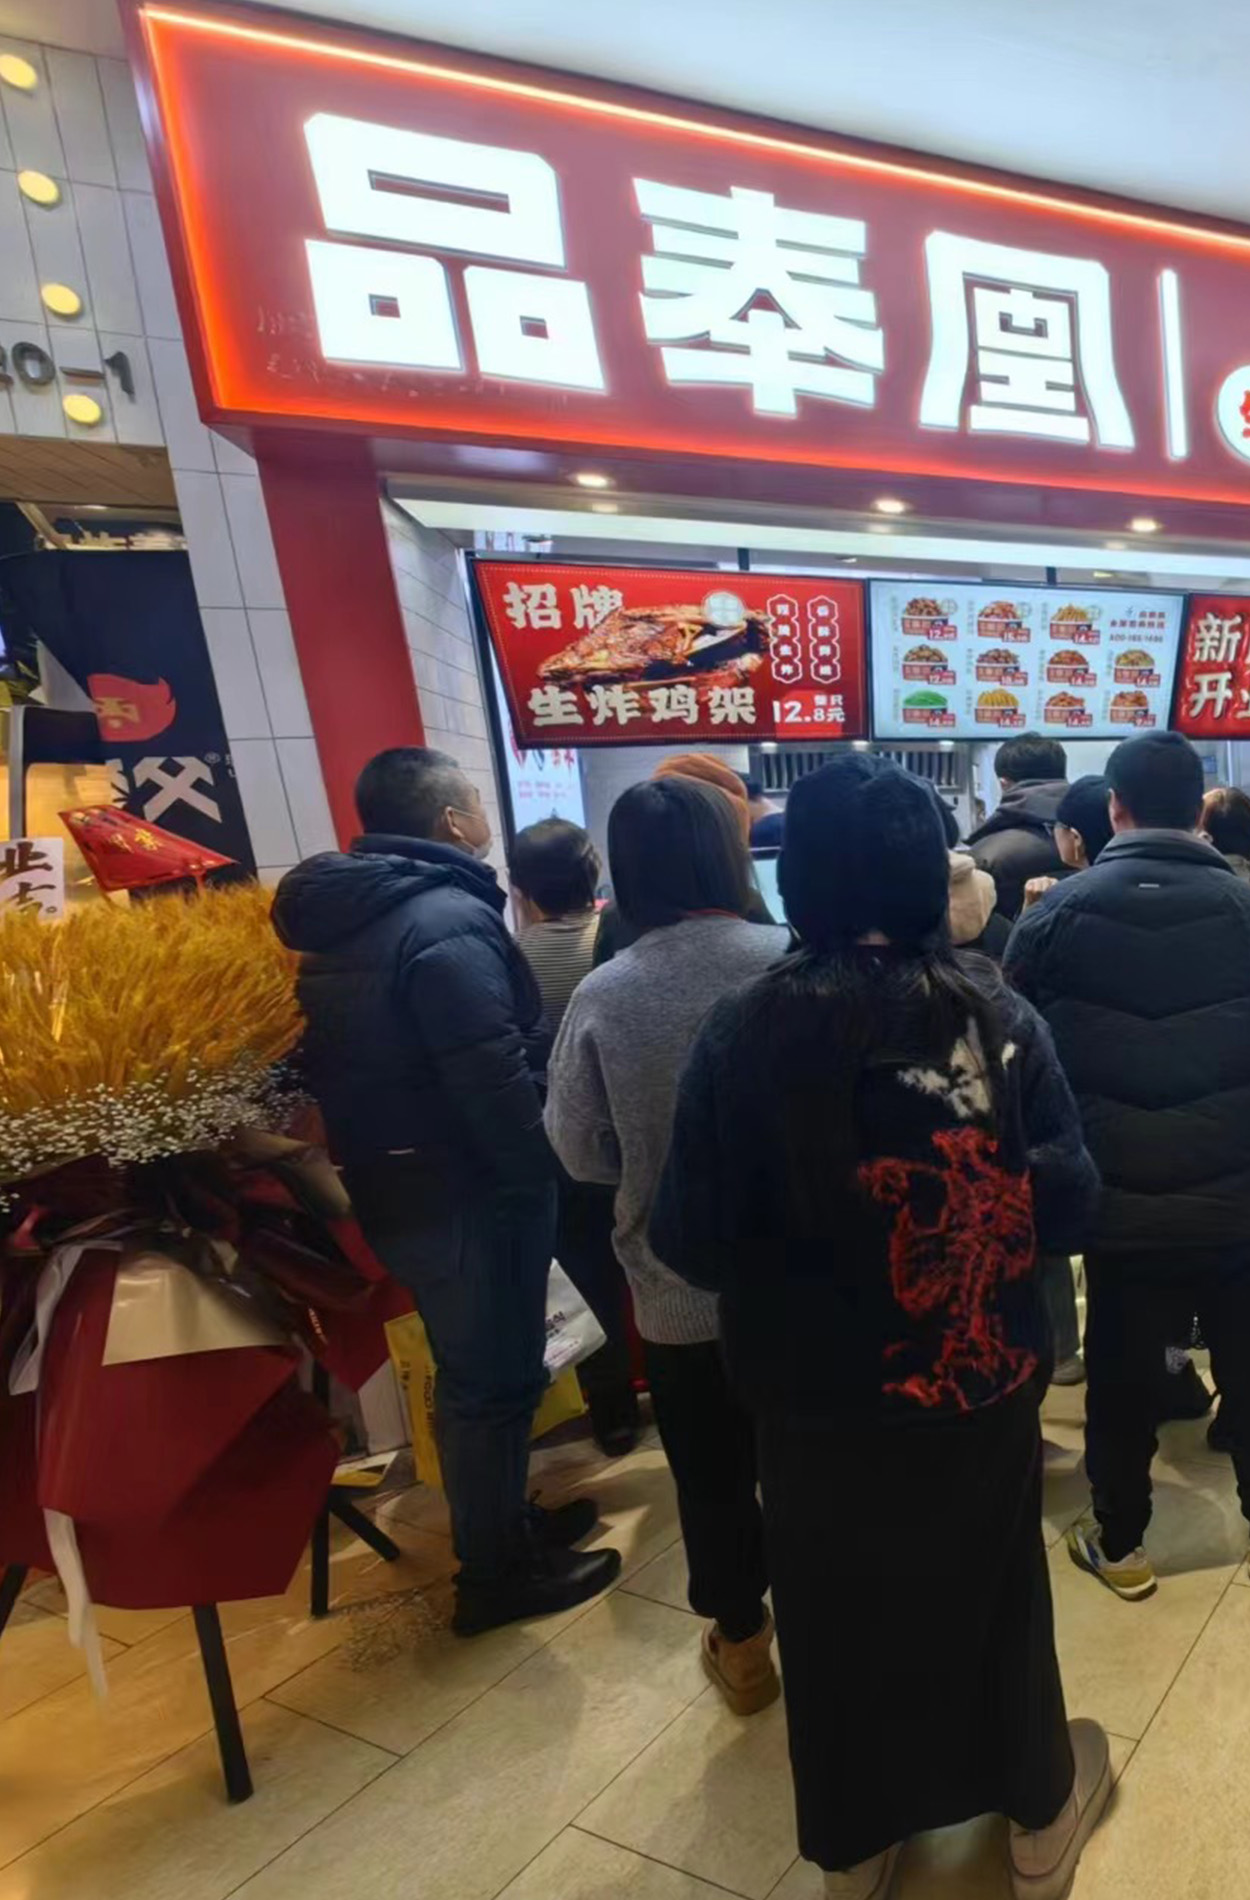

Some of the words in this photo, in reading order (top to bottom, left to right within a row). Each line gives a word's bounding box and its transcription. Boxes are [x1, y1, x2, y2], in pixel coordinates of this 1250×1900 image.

[303, 112, 1134, 450] 品奉凰
[502, 581, 624, 630] 招牌
[527, 684, 757, 727] 生炸鸡架
